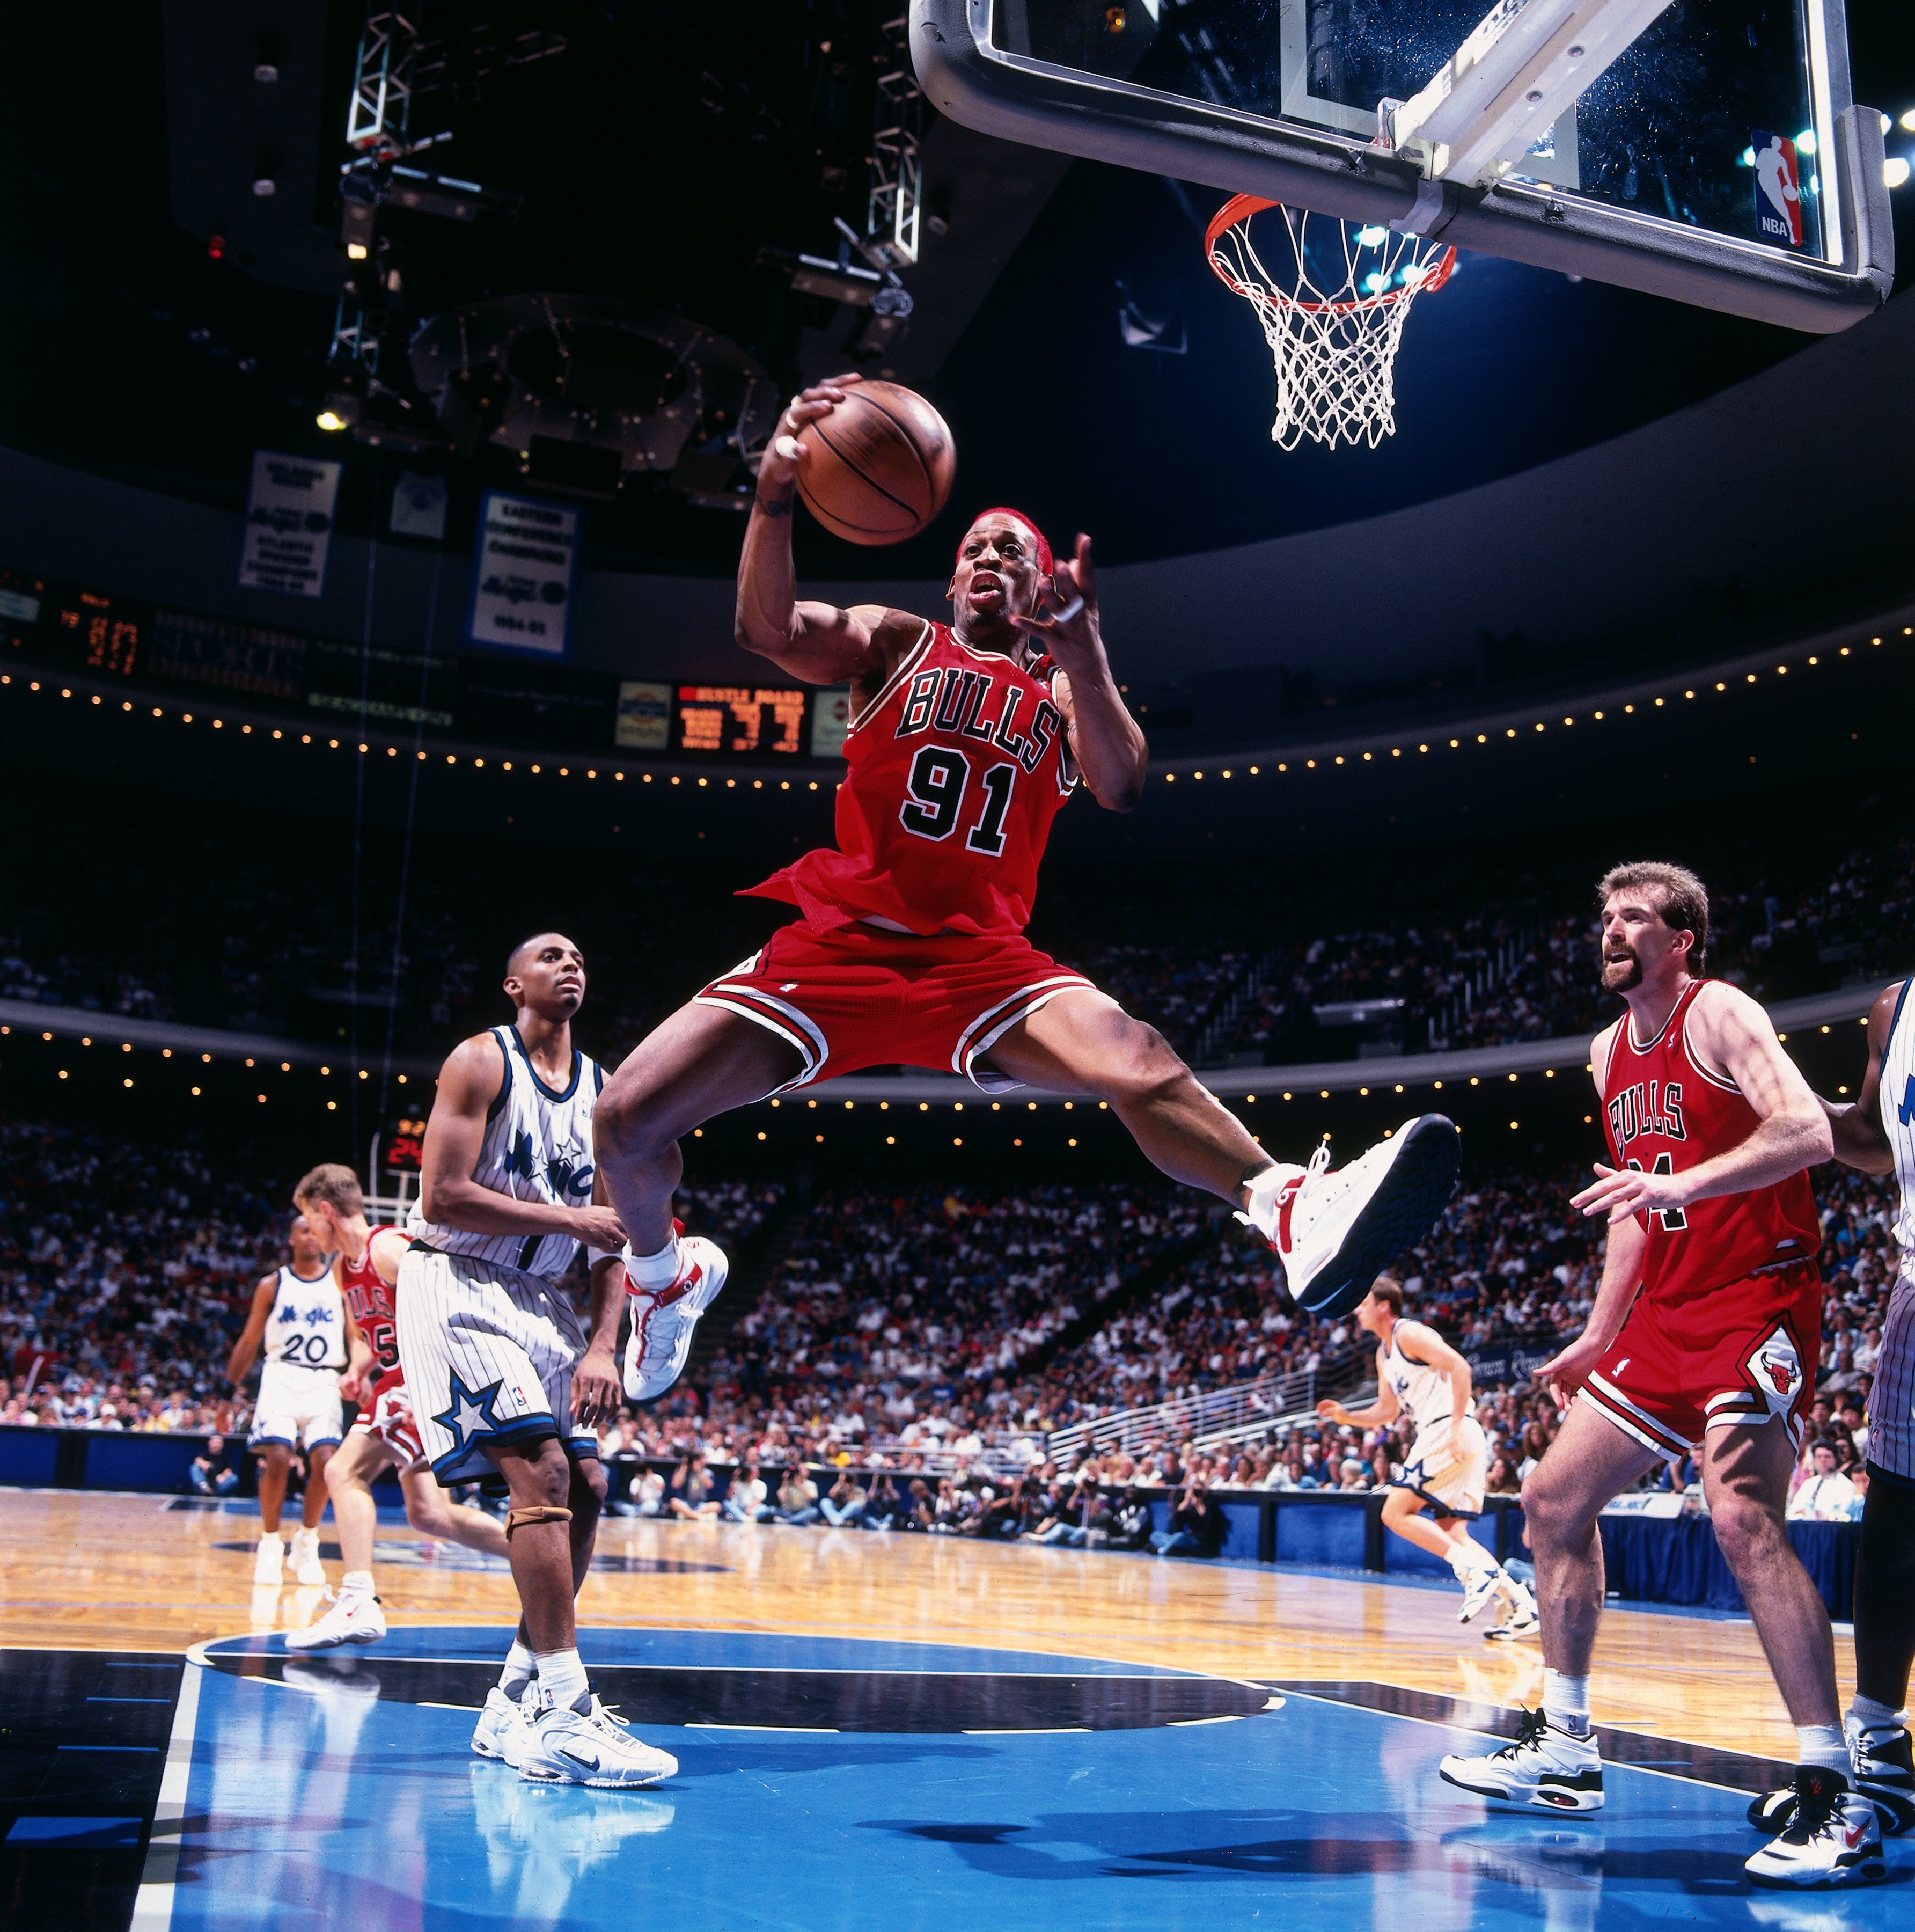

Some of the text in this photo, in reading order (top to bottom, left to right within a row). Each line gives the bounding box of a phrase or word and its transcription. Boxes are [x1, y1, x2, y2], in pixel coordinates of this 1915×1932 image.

[1762, 216, 1787, 237] NBA
[754, 690, 804, 705] BOARD
[894, 667, 1060, 774] BULLS
[899, 744, 1017, 857] 91
[1608, 1079, 1687, 1161] BULLS
[387, 1137, 423, 1166] 24
[1627, 1152, 1688, 1232] 4
[281, 1334, 328, 1363] 20
[361, 1322, 400, 1372] 5
